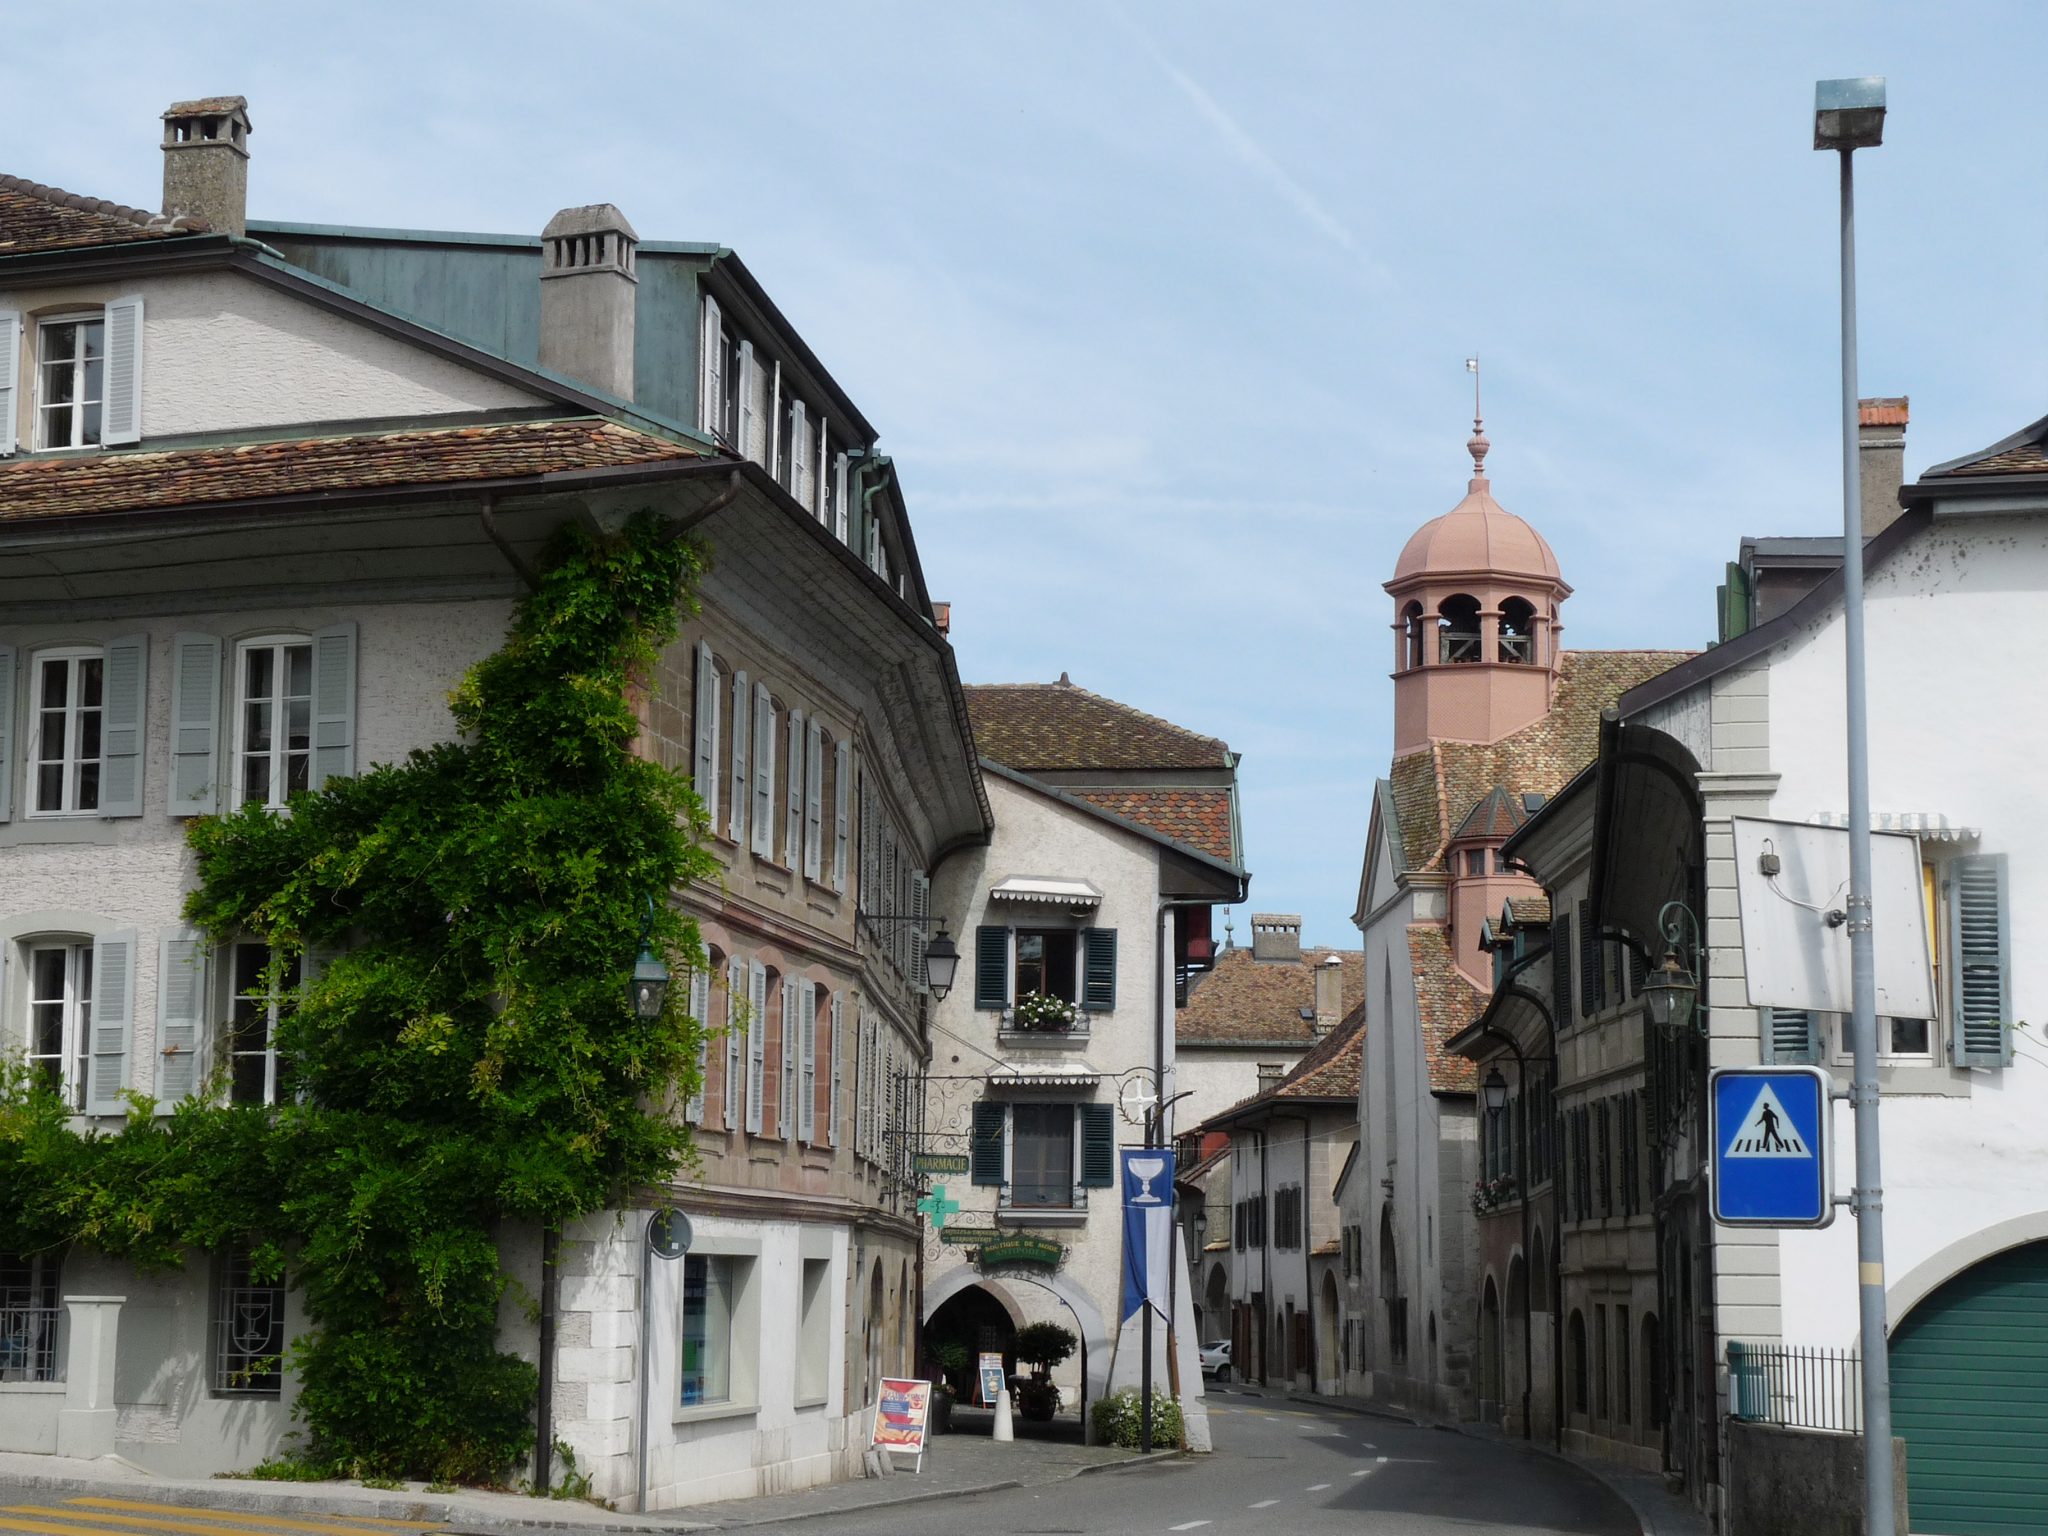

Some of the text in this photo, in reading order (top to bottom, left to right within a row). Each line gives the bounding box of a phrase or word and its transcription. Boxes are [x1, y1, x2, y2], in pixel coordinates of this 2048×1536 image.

[916, 1157, 967, 1170] PHARMACIE
[985, 1241, 1020, 1252] BOUTIQUE
[1037, 1243, 1058, 1252] MODE
